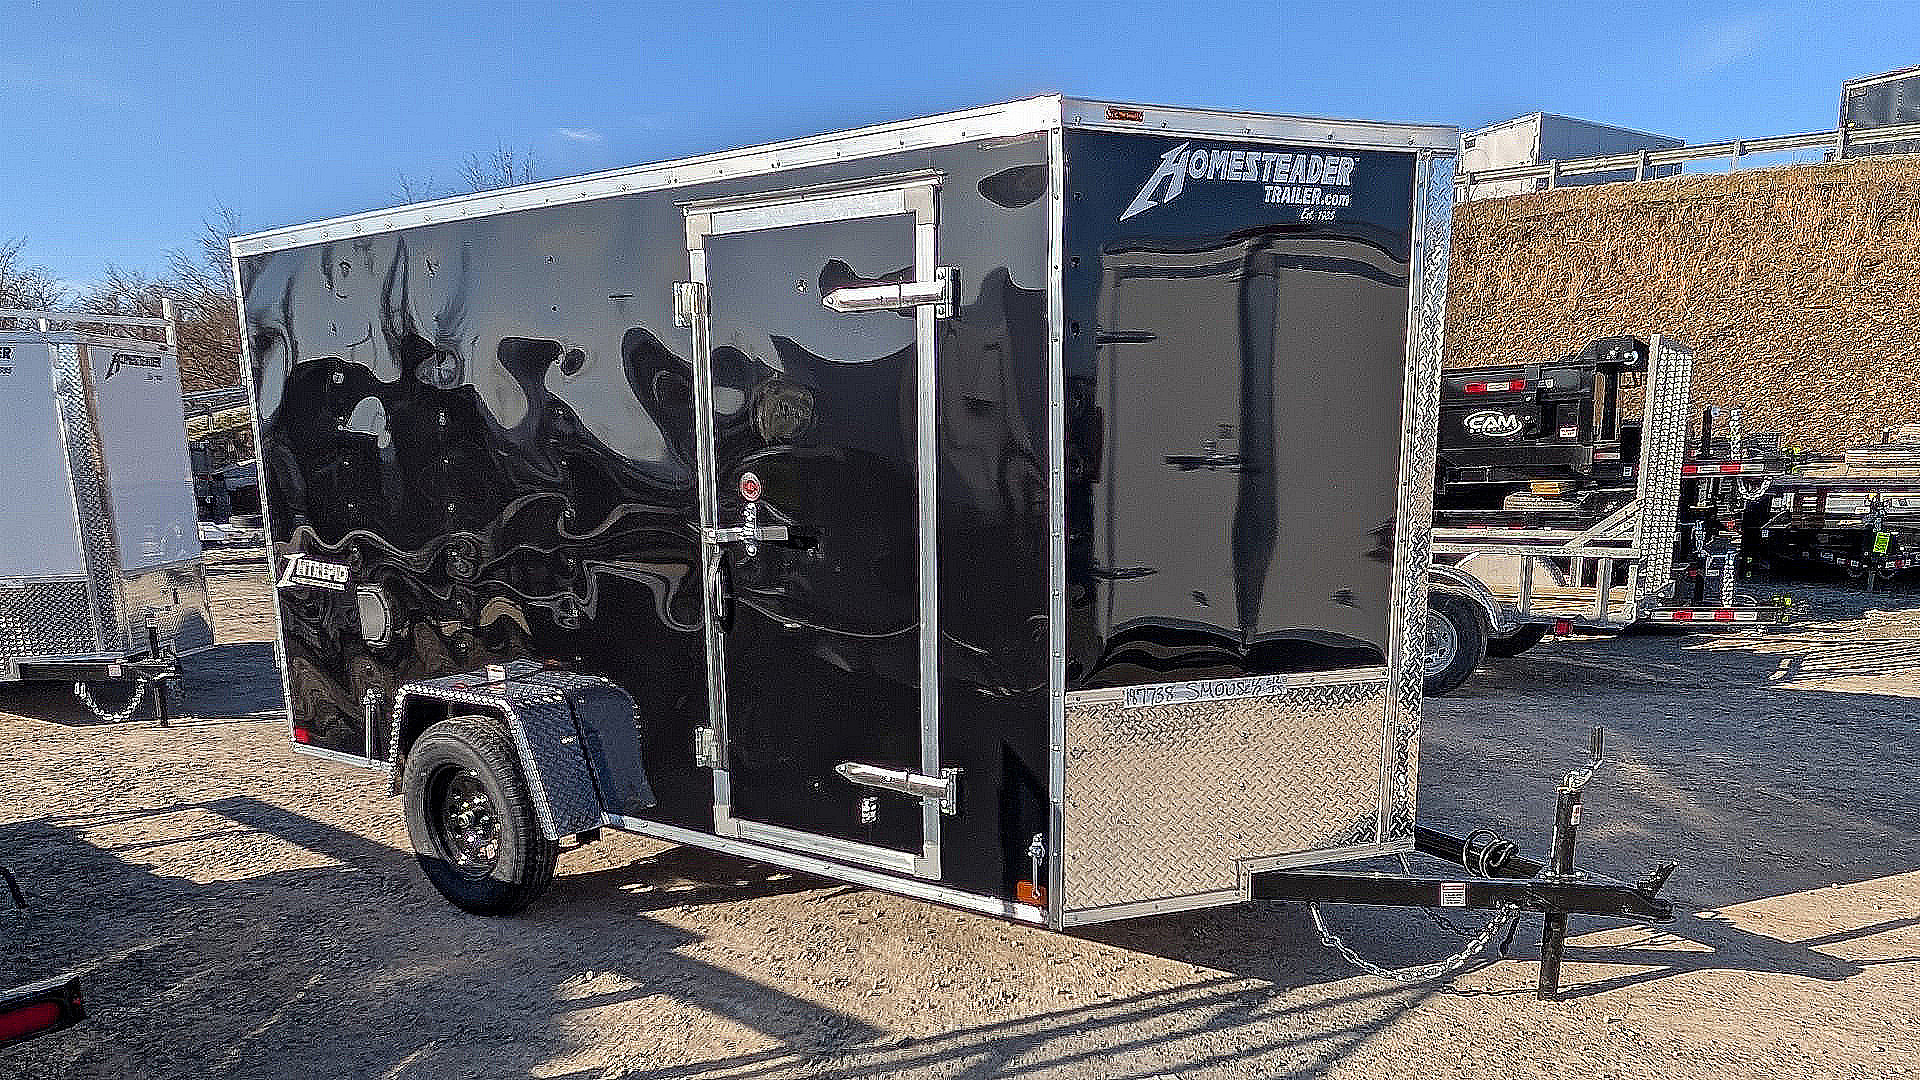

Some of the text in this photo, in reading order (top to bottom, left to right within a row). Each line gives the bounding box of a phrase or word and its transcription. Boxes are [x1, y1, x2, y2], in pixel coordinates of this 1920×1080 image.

[1119, 141, 1356, 222] HOMESTEADER
[1264, 185, 1350, 207] TRAILER.com
[1469, 413, 1519, 429] CAM
[277, 553, 349, 587] INTREPID
